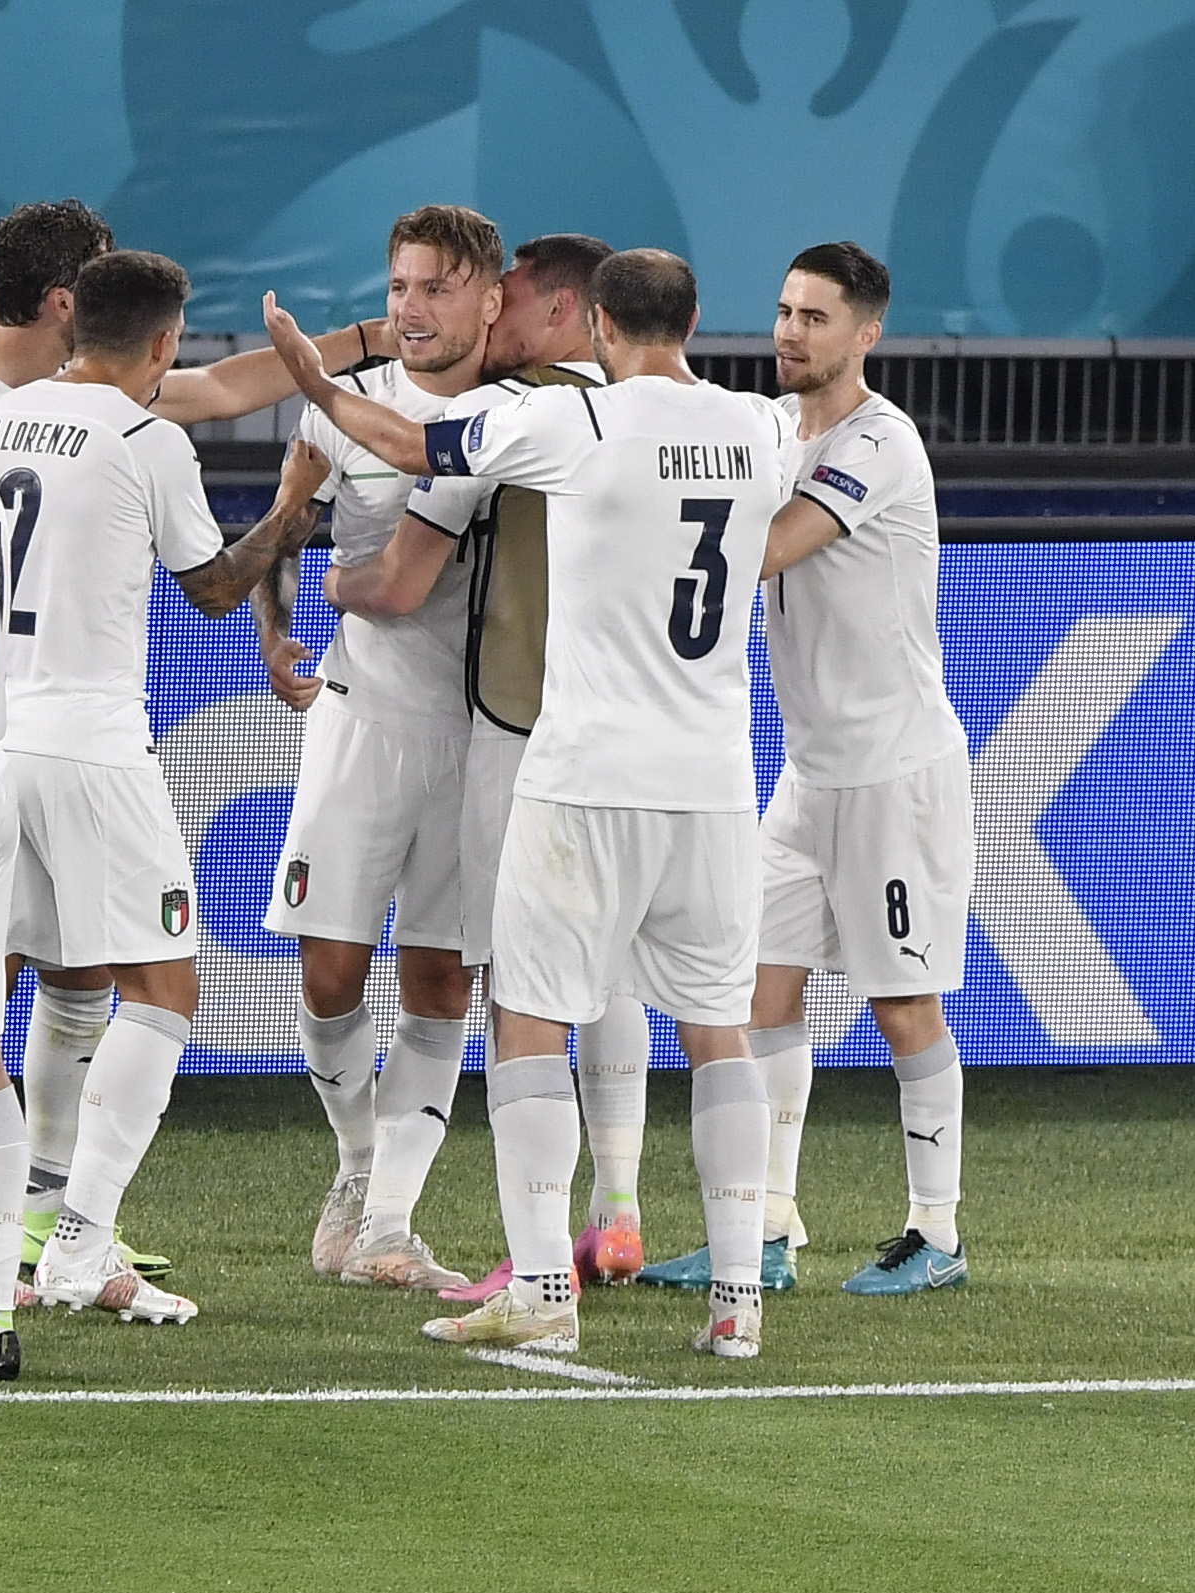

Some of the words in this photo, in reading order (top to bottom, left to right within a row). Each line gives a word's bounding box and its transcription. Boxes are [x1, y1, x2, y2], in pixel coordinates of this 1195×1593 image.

[0, 420, 89, 458] LORENZO
[658, 445, 753, 480] CHIELLINI
[827, 473, 866, 498] RESPECT
[668, 498, 735, 660] 3
[885, 878, 911, 940] 8
